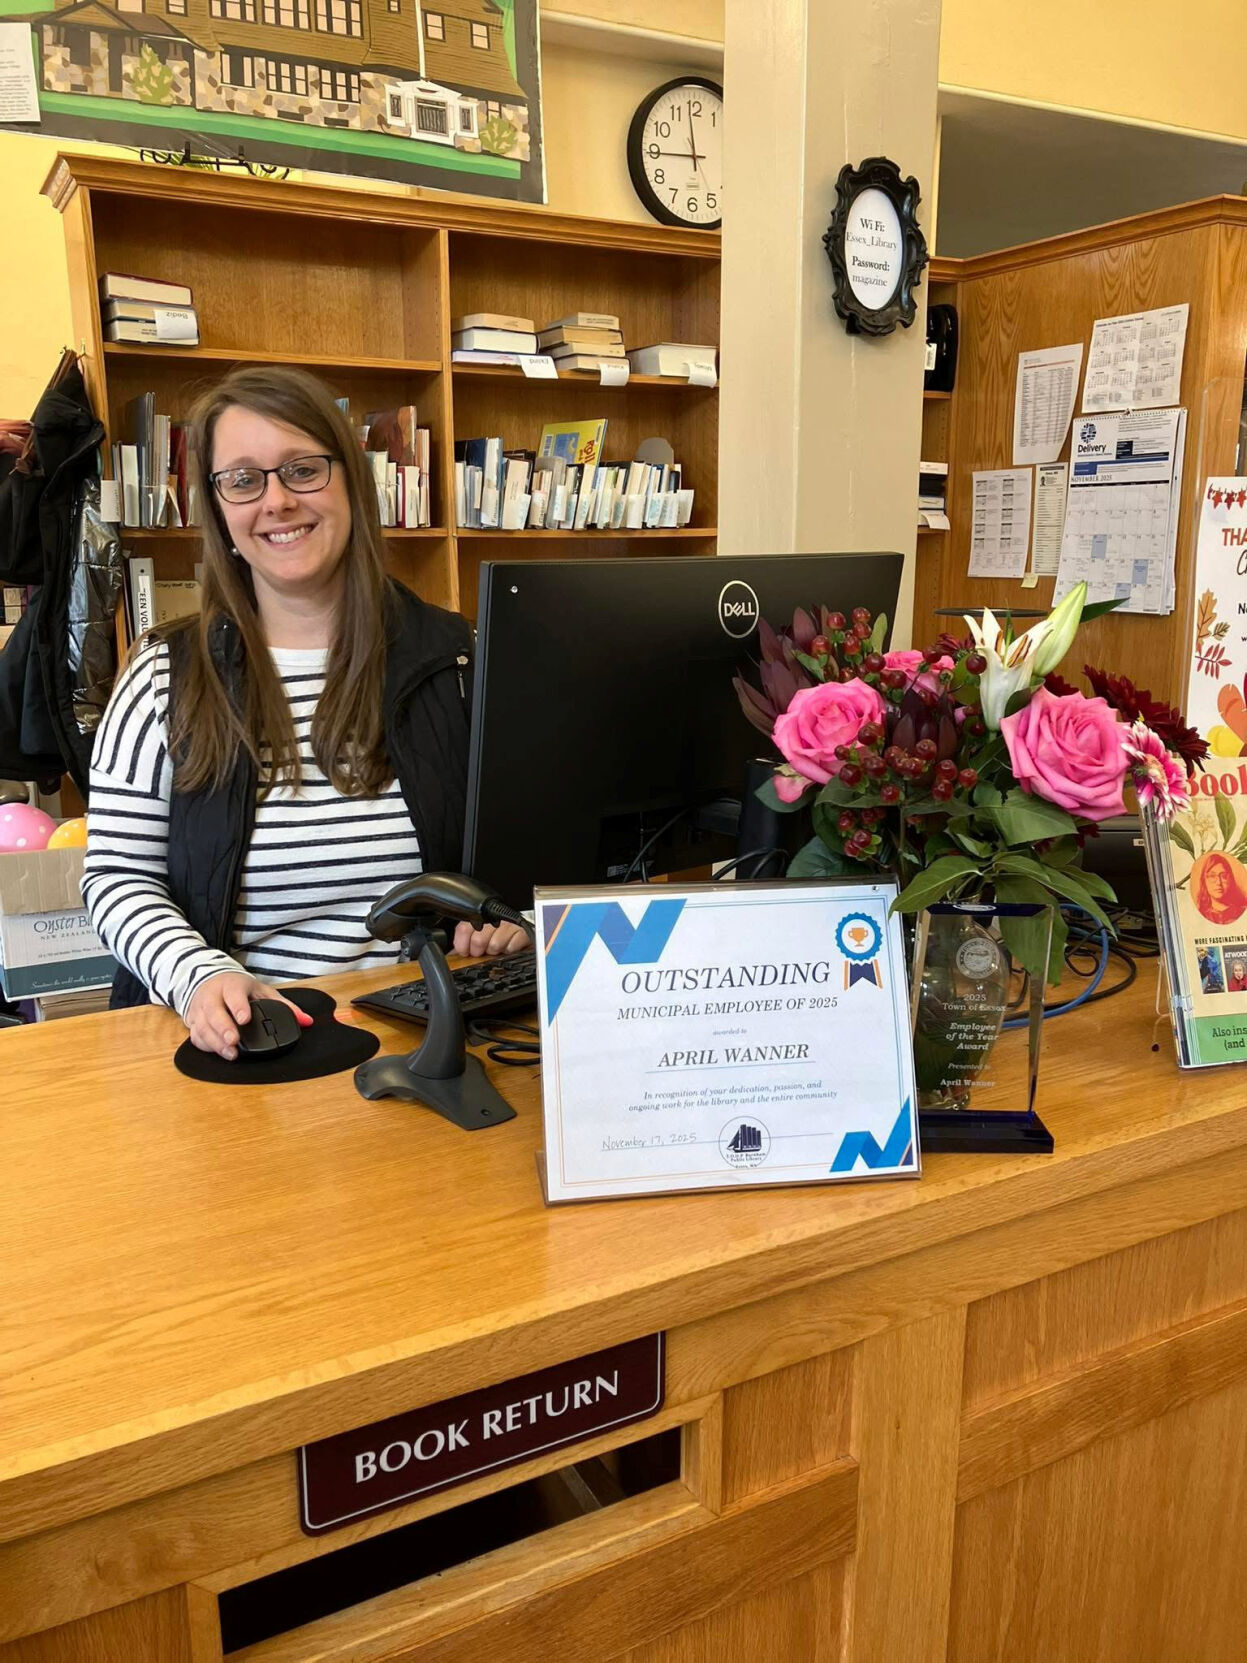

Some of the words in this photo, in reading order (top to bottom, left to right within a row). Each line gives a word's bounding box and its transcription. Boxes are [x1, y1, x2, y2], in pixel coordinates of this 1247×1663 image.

[670, 104, 681, 122] 11
[687, 100, 702, 117] 12
[711, 112, 716, 127] 1
[654, 121, 671, 138] 10
[648, 143, 660, 159] 9
[654, 168, 665, 184] 8
[669, 188, 679, 203] 7
[706, 193, 717, 208] 5
[687, 197, 698, 212] 6
[846, 231, 897, 251] Essex_Library
[852, 256, 890, 272] Password:
[852, 274, 888, 287] magazine
[1077, 444, 1106, 453] Delivery
[724, 602, 756, 617] DELL
[33, 916, 76, 934] Oyster
[621, 961, 830, 994] OUTSTANDING
[617, 1004, 700, 1021] MUNICIPAL
[704, 999, 783, 1015] EMPLOYEE
[786, 998, 807, 1010] OF
[809, 997, 838, 1009] 2025
[942, 1002, 966, 1011] Town
[968, 1002, 979, 1011] of
[713, 1028, 739, 1036] awarded
[950, 1022, 997, 1032] Employee
[1212, 1027, 1231, 1038] Also
[946, 1032, 957, 1041] of
[958, 1032, 974, 1041] the
[977, 1033, 999, 1041] Year
[1224, 1037, 1246, 1051] (and
[956, 1042, 989, 1050] Award
[657, 1050, 719, 1068] APRIL
[724, 1044, 810, 1063] WANNER
[644, 1092, 653, 1100] In
[655, 1089, 698, 1100] recognition
[700, 1087, 708, 1096] of
[709, 1087, 727, 1097] your
[729, 1085, 772, 1094] dedication,
[773, 1083, 805, 1093] passion,
[806, 1080, 822, 1089] and
[940, 1078, 962, 1087] April
[963, 1079, 996, 1087] Wanner
[628, 1103, 660, 1112] ongoing
[662, 1099, 682, 1109] work
[684, 1098, 694, 1109] for
[696, 1099, 709, 1107] the
[711, 1097, 738, 1107] library
[740, 1095, 756, 1104] and
[757, 1094, 769, 1103] the
[771, 1093, 793, 1102] entire
[795, 1091, 838, 1101] community
[602, 1135, 646, 1150] November
[670, 1132, 697, 1143] 2025
[354, 1418, 471, 1484] BOOK
[482, 1369, 619, 1440] RETURN
